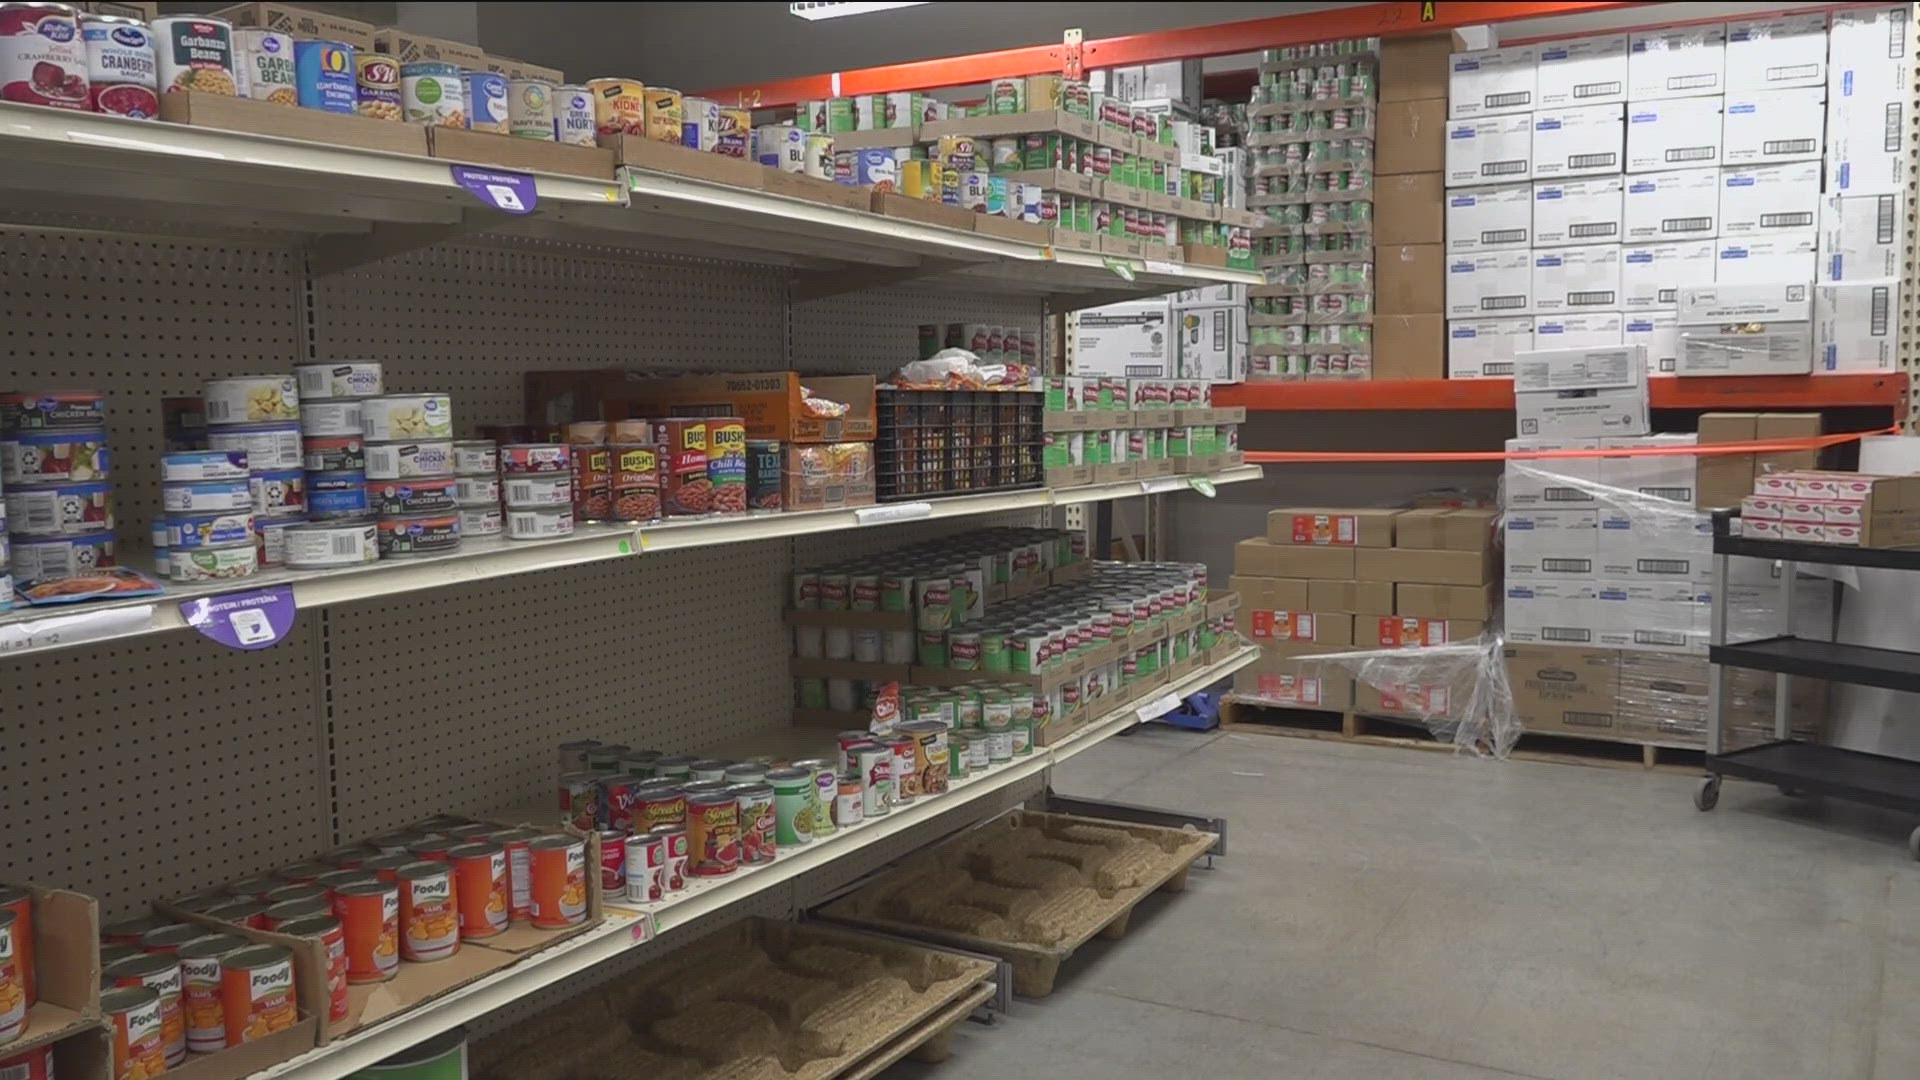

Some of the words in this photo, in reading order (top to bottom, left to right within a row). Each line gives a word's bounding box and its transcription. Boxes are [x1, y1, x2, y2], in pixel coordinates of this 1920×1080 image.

[1423, 2, 1434, 21] A
[180, 35, 227, 50] Garbanzo
[190, 48, 222, 61] Beans
[261, 69, 296, 85] BEAN
[612, 100, 641, 113] KIDNE
[463, 171, 489, 181] PROTEIN
[969, 185, 987, 197] BLA
[622, 455, 655, 468] BUSH'S
[710, 459, 733, 470] Chili
[622, 473, 656, 483] Original
[412, 881, 447, 896] Foody
[252, 966, 290, 987] Foody
